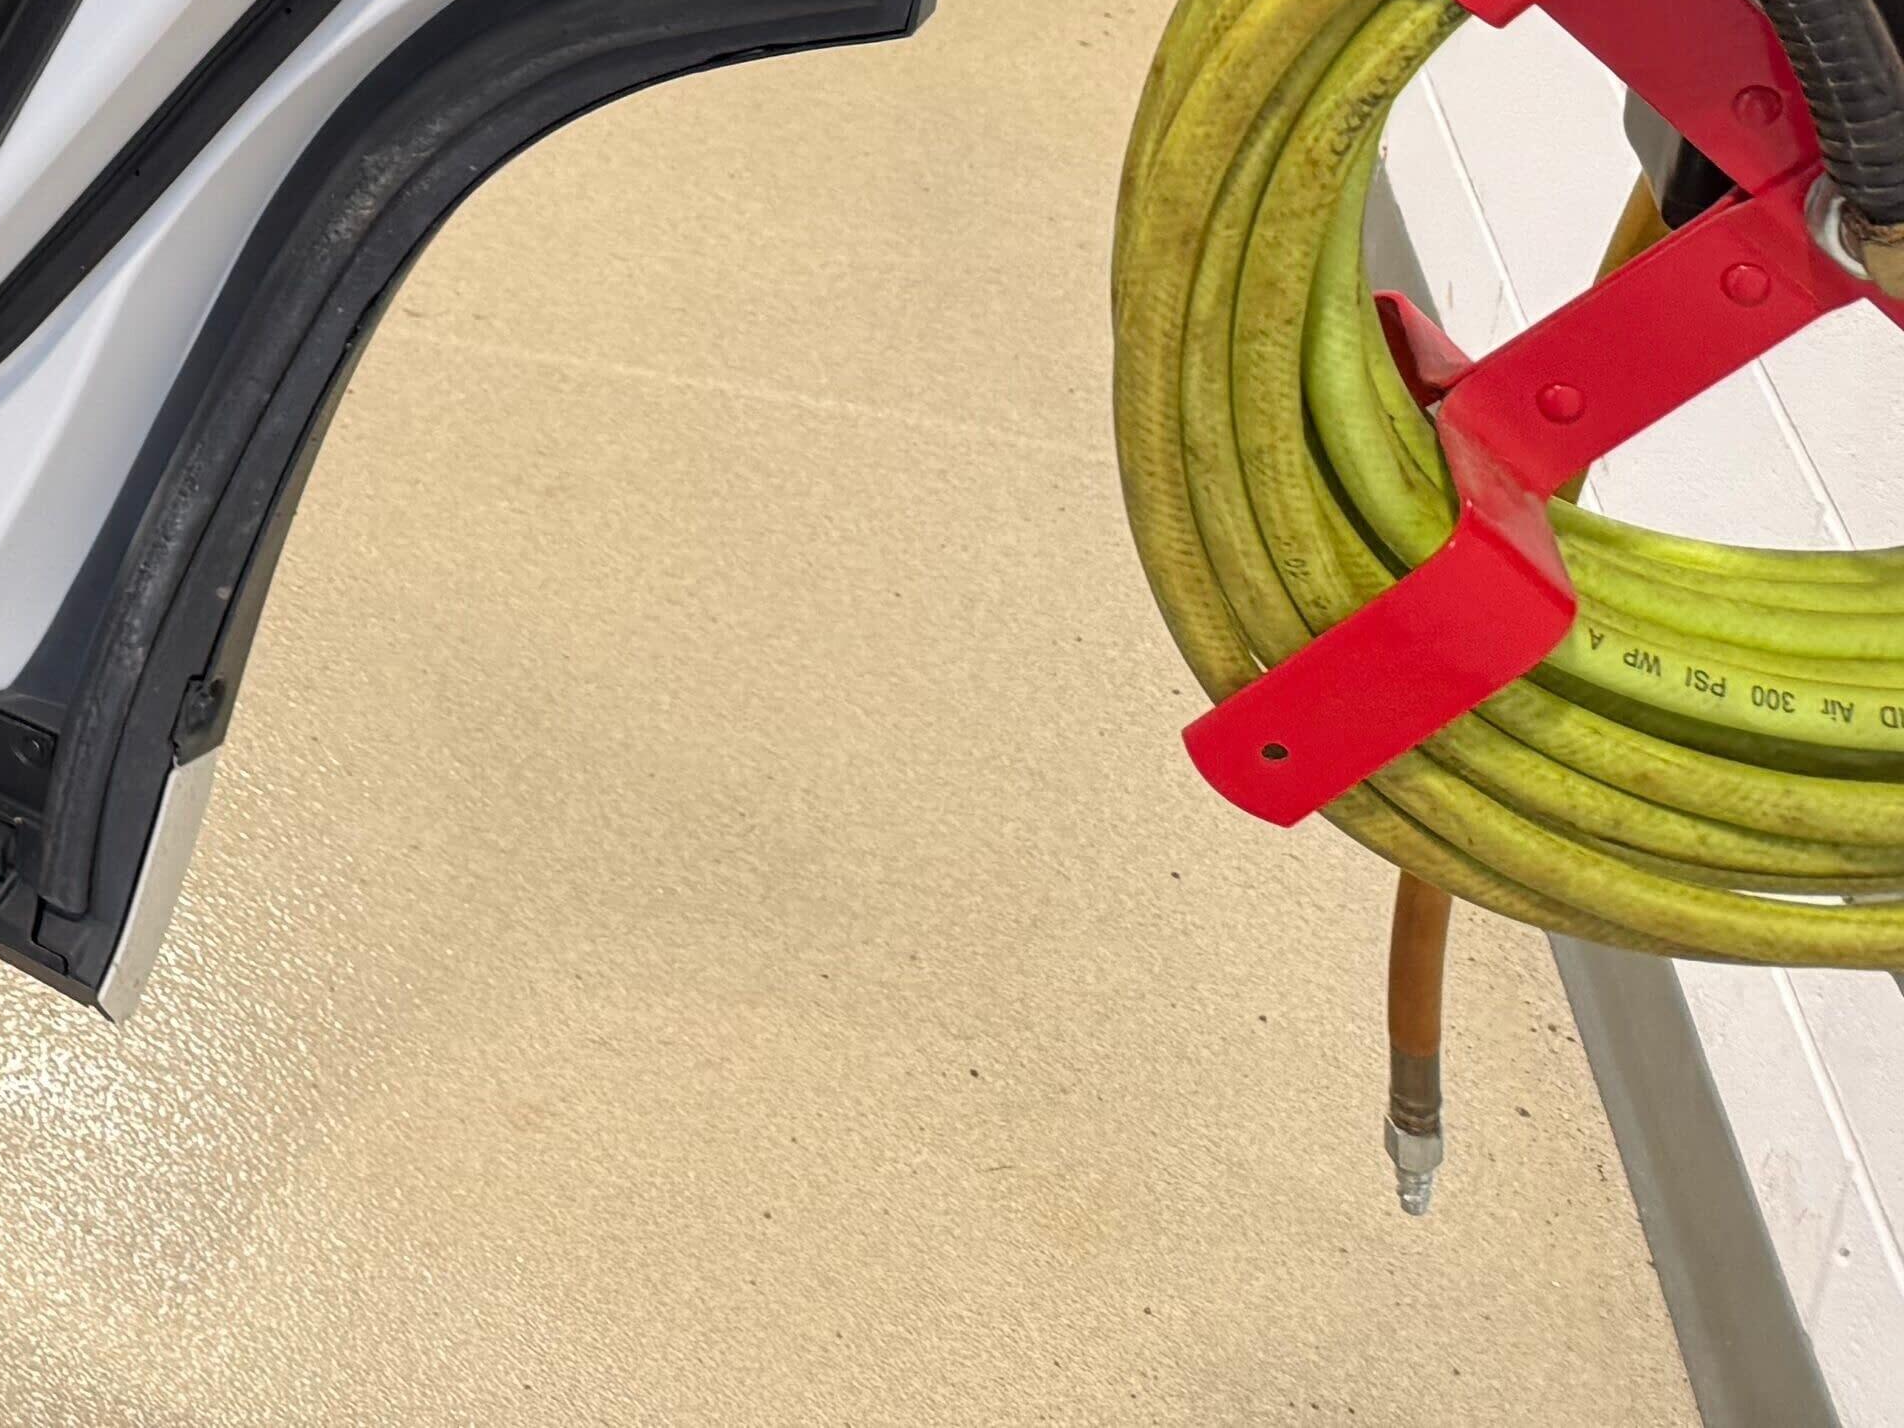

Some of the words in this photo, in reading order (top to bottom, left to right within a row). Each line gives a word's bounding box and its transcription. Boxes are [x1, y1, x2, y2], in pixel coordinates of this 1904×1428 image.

[1622, 647, 1662, 678] WP
[1684, 665, 1728, 698] PSI
[1751, 684, 1796, 714] 300
[1821, 697, 1855, 724] Air
